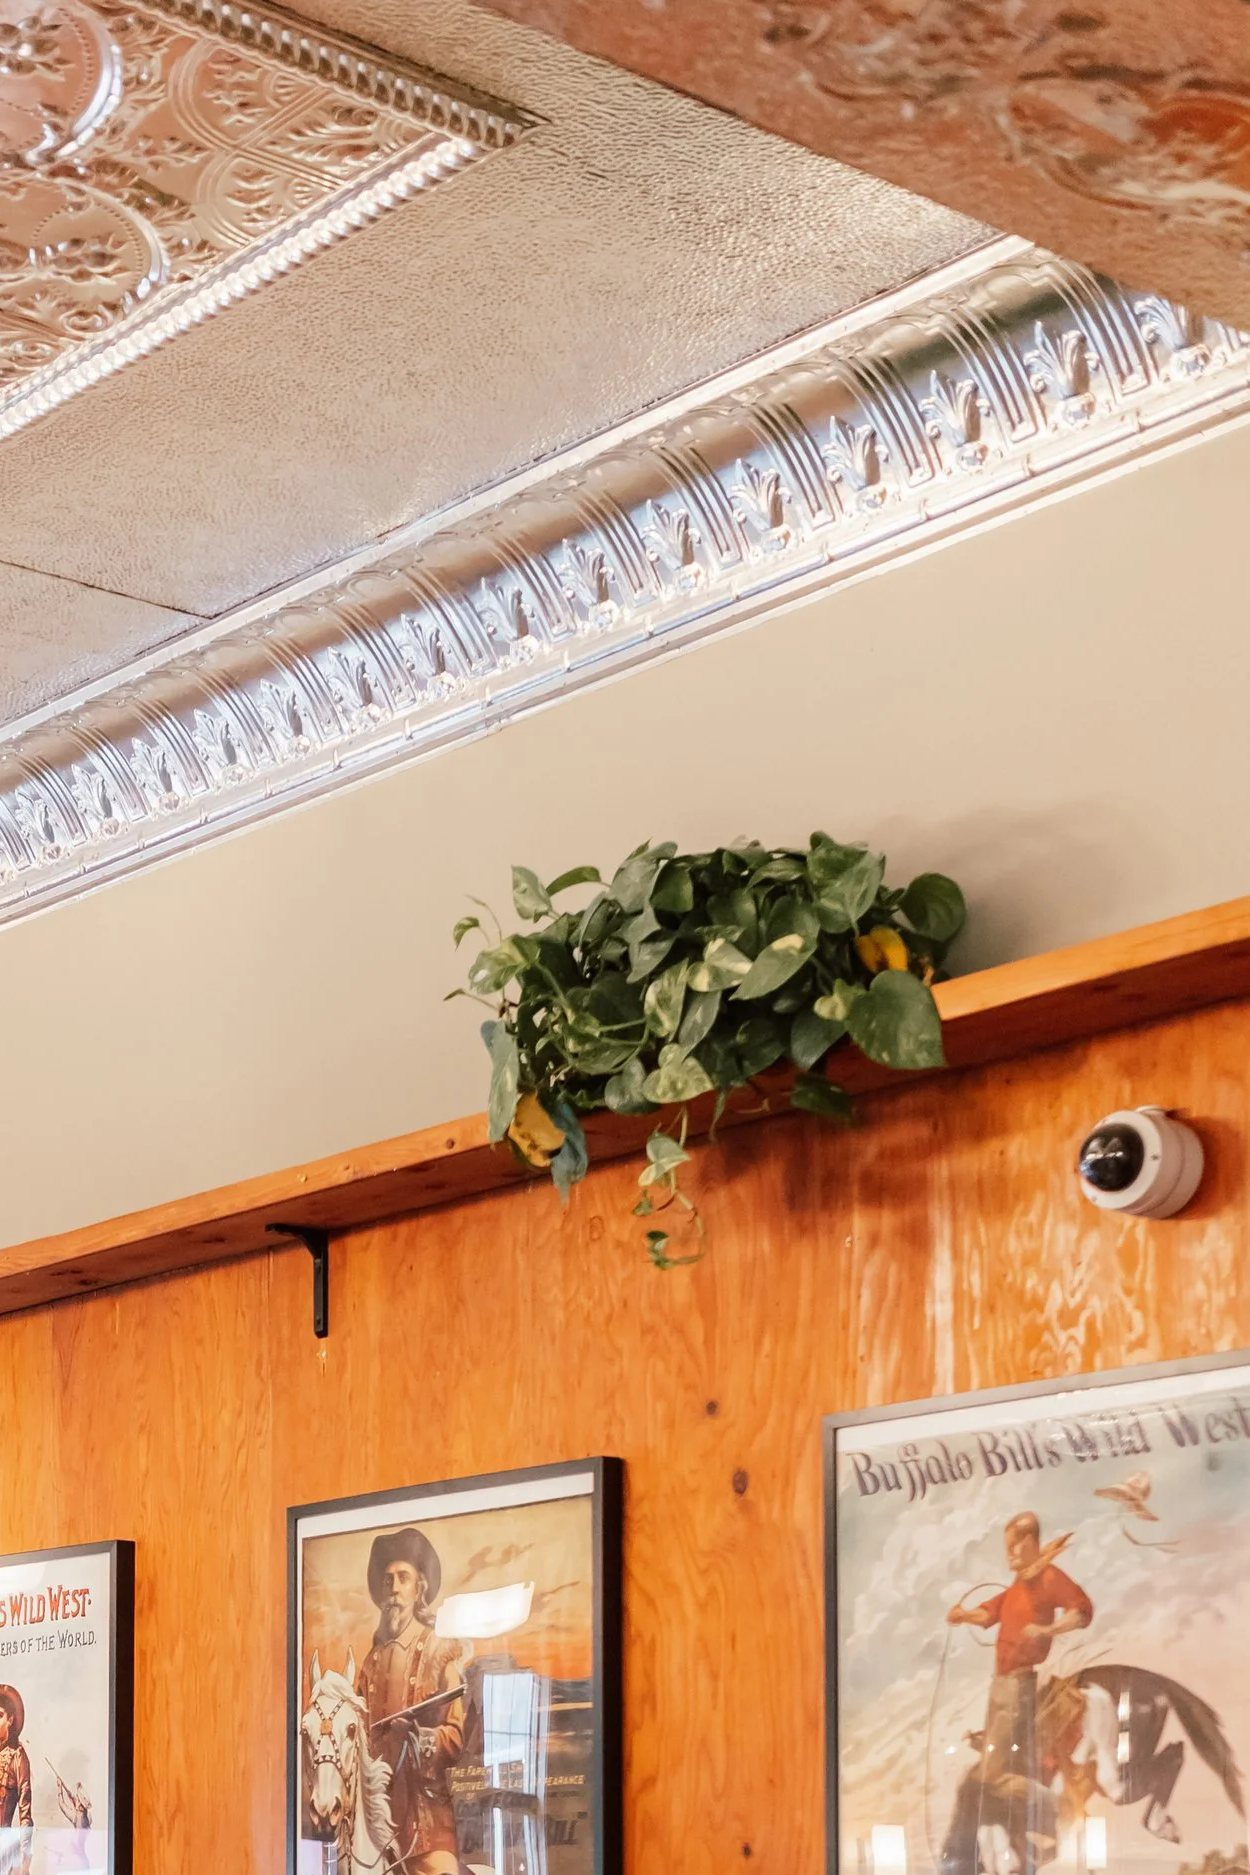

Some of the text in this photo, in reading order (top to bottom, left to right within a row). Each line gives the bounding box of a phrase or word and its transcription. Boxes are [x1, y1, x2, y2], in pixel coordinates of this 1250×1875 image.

[846, 1395, 1250, 1502] Buffalo Bill's Wild West
[9, 1592, 46, 1626] WILD
[20, 1637, 34, 1654] OF
[35, 1635, 55, 1652] THE
